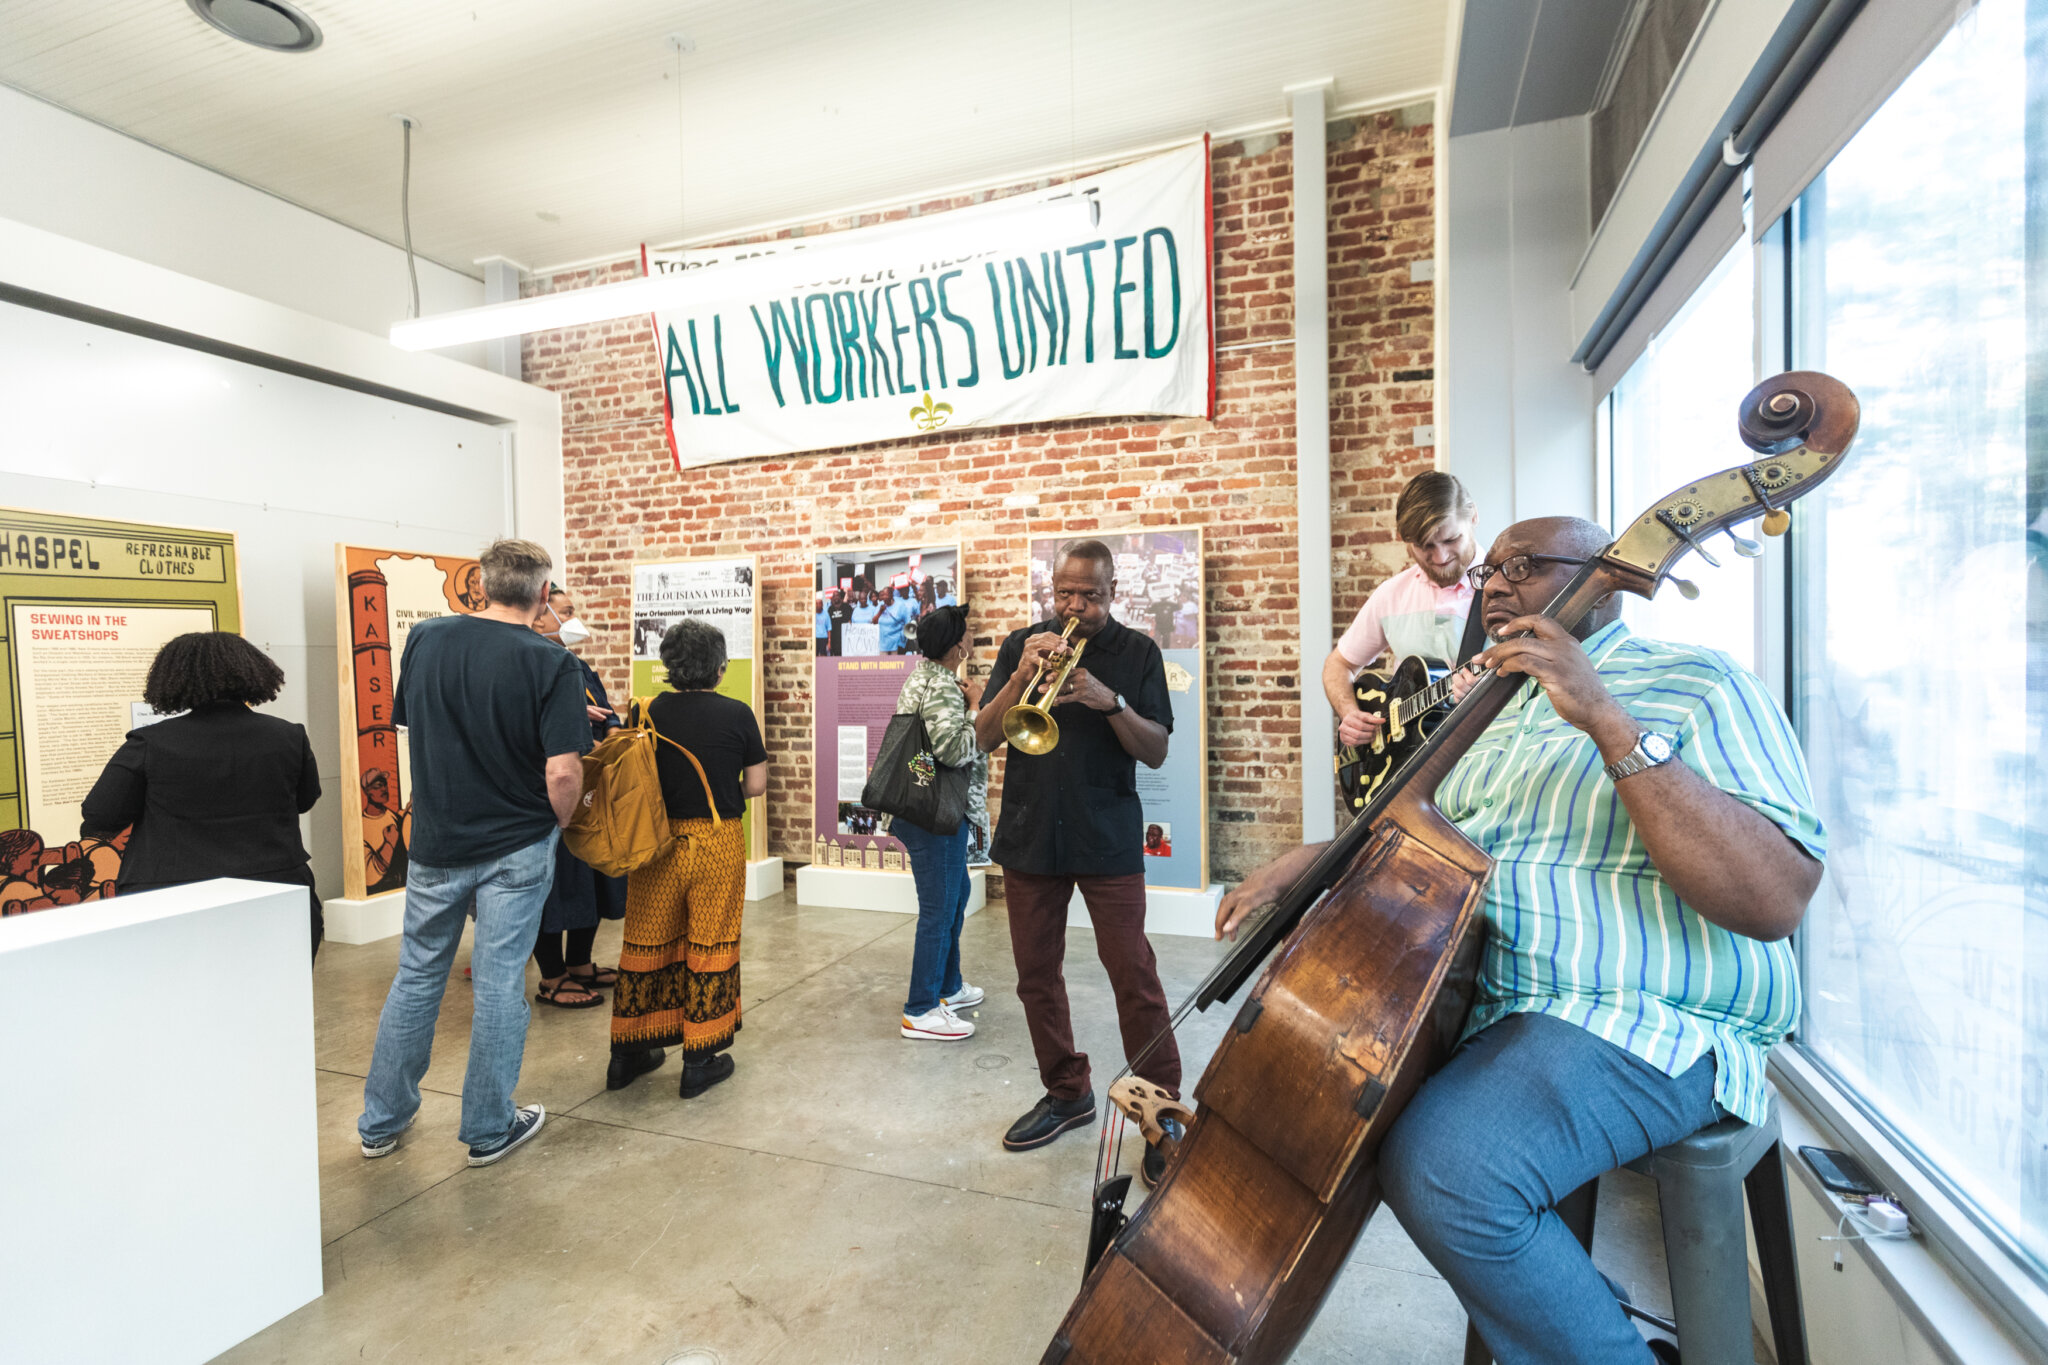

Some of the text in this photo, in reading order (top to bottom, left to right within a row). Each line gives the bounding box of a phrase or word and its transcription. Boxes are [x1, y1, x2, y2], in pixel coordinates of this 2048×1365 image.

[664, 226, 1181, 419] ALL WORKERS UNITED
[139, 558, 195, 575] CLOTHES
[30, 613, 128, 627] SEWING IN THE
[396, 609, 414, 619] CIVIL
[31, 629, 119, 641] SWEATSHOPS
[837, 661, 905, 671] STAND WITH DIGNITY
